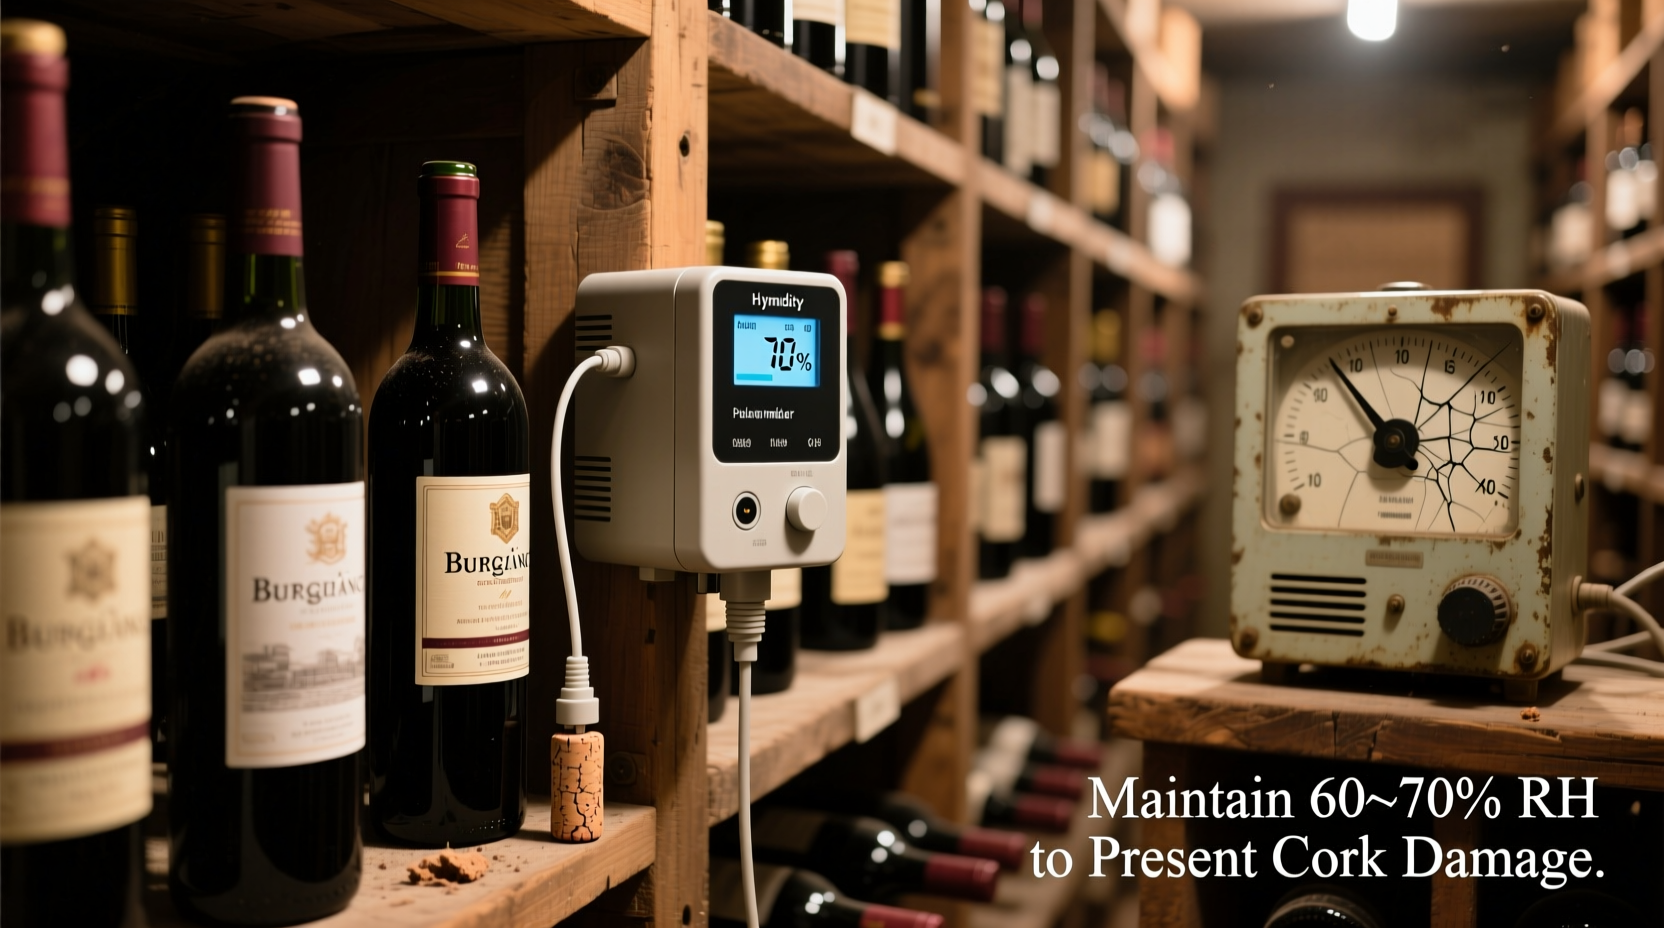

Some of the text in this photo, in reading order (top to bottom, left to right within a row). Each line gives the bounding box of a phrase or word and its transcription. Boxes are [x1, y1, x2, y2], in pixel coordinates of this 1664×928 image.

[763, 336, 812, 371] 70%
[1395, 349, 1410, 364] 10
[1349, 357, 1363, 373] 10
[1308, 472, 1322, 487] 10
